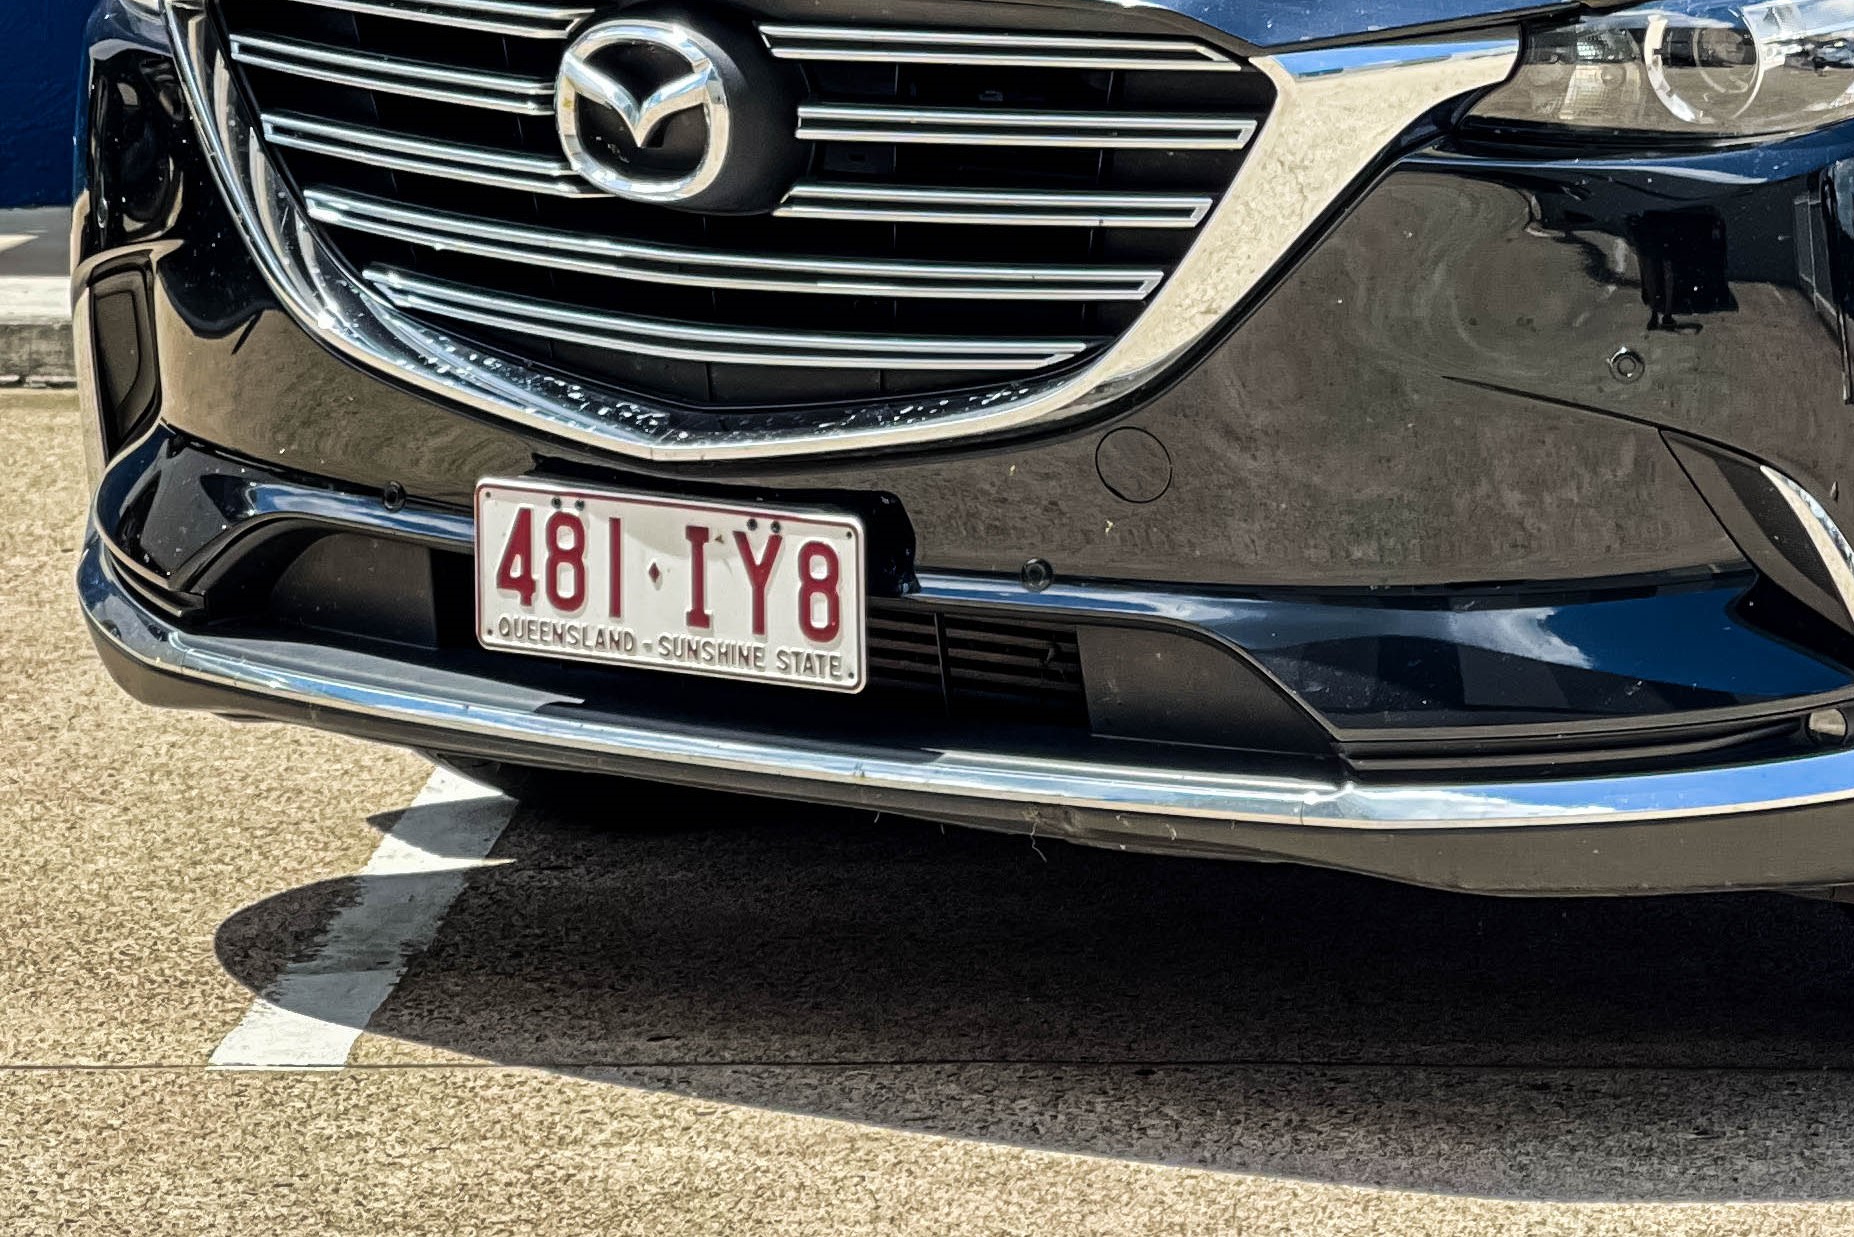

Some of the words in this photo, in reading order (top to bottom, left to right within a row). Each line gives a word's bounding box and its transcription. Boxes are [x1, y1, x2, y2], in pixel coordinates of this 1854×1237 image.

[496, 508, 621, 617] 481
[685, 525, 840, 643] IY8
[498, 615, 636, 653] QUEENSLAND
[658, 634, 766, 669] SUNSHINE
[776, 647, 844, 681] STATE
